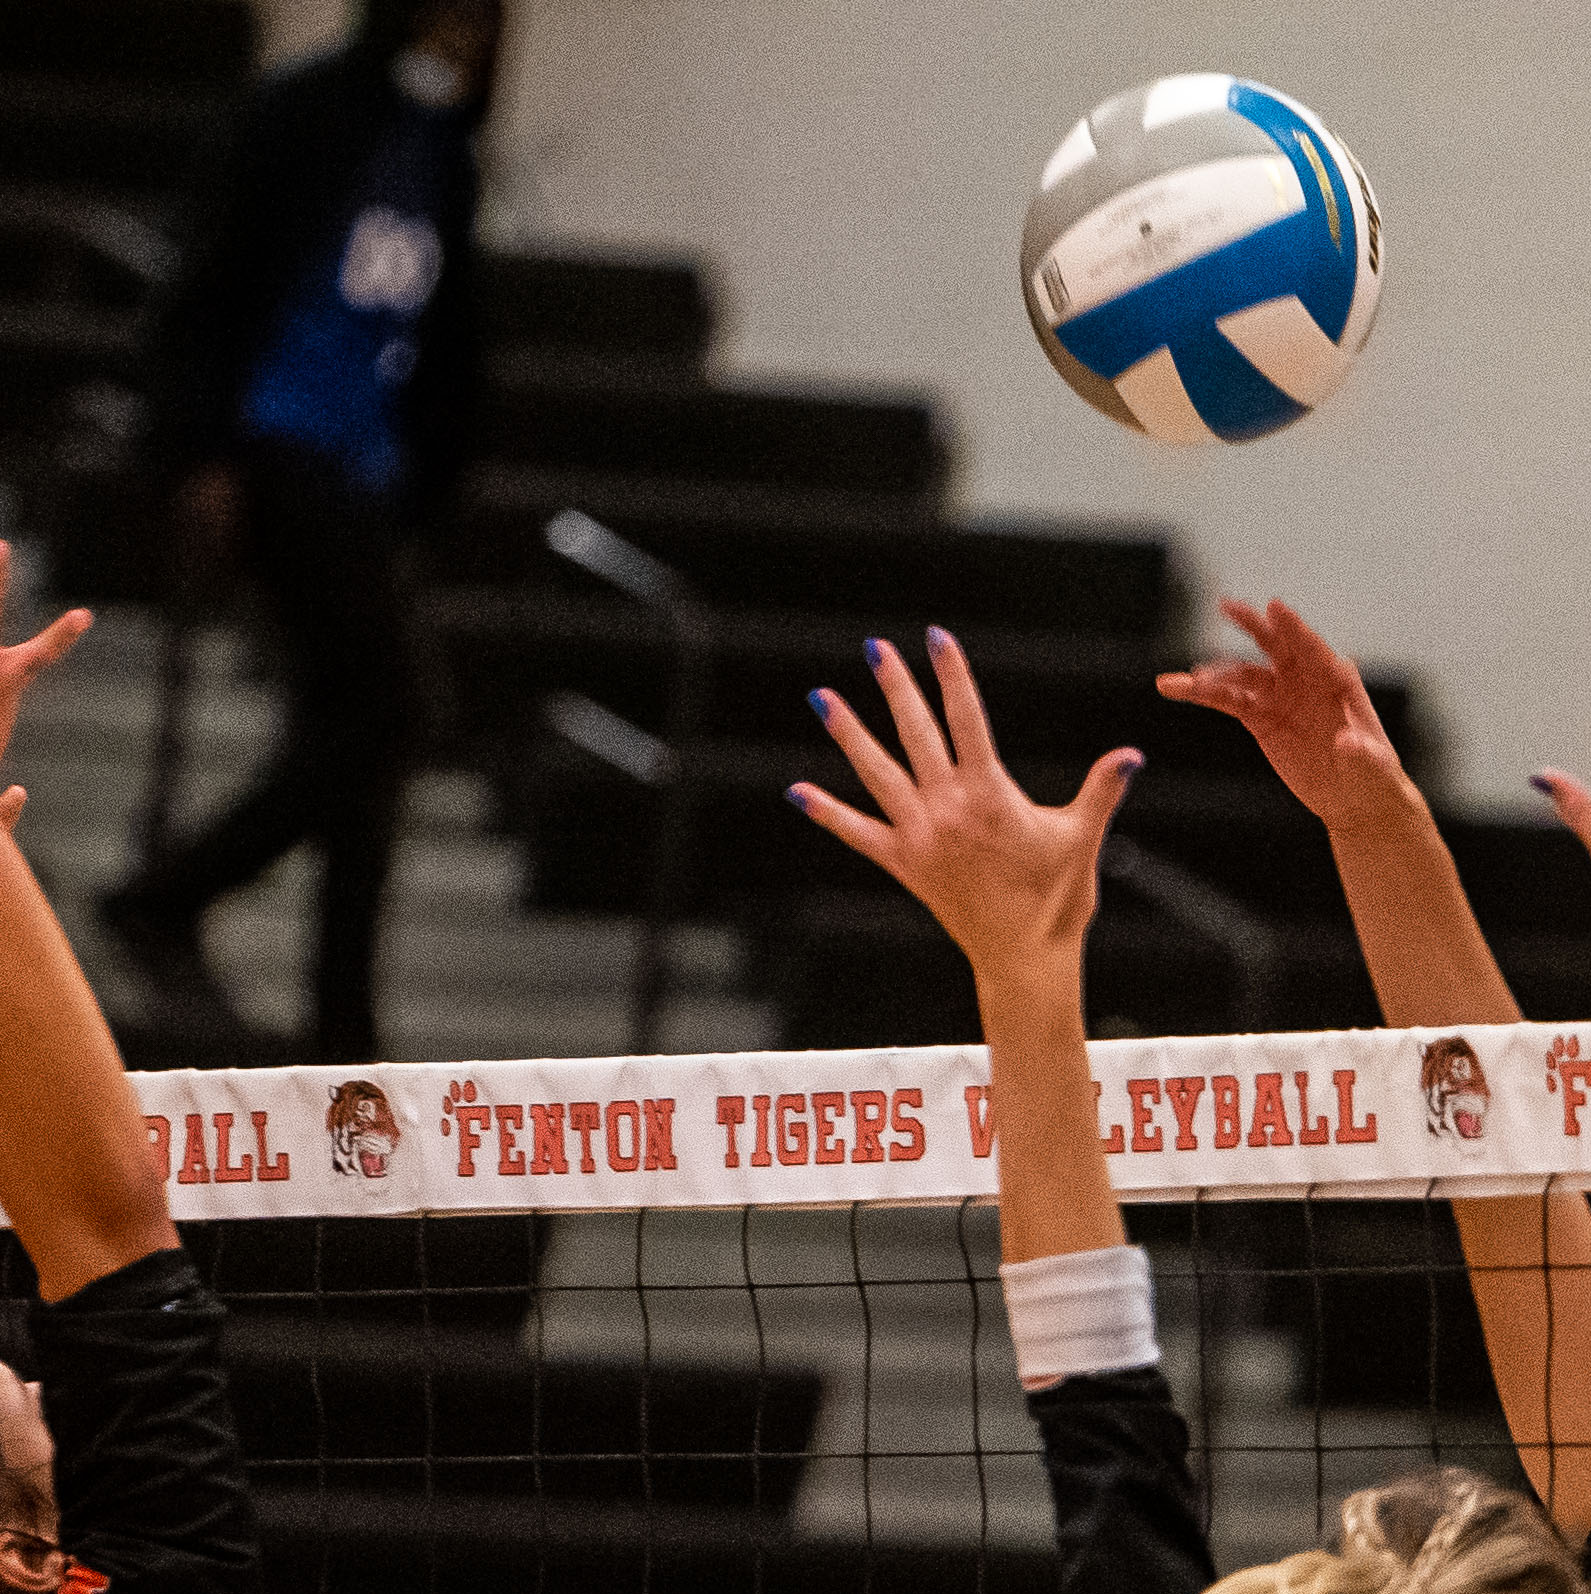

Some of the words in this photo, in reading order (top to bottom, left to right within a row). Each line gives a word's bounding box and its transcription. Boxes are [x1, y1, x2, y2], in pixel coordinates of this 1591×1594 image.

[456, 1099, 677, 1177] FENTON
[716, 1088, 926, 1168] TIGERS
[964, 1069, 1377, 1159] VEYBALL
